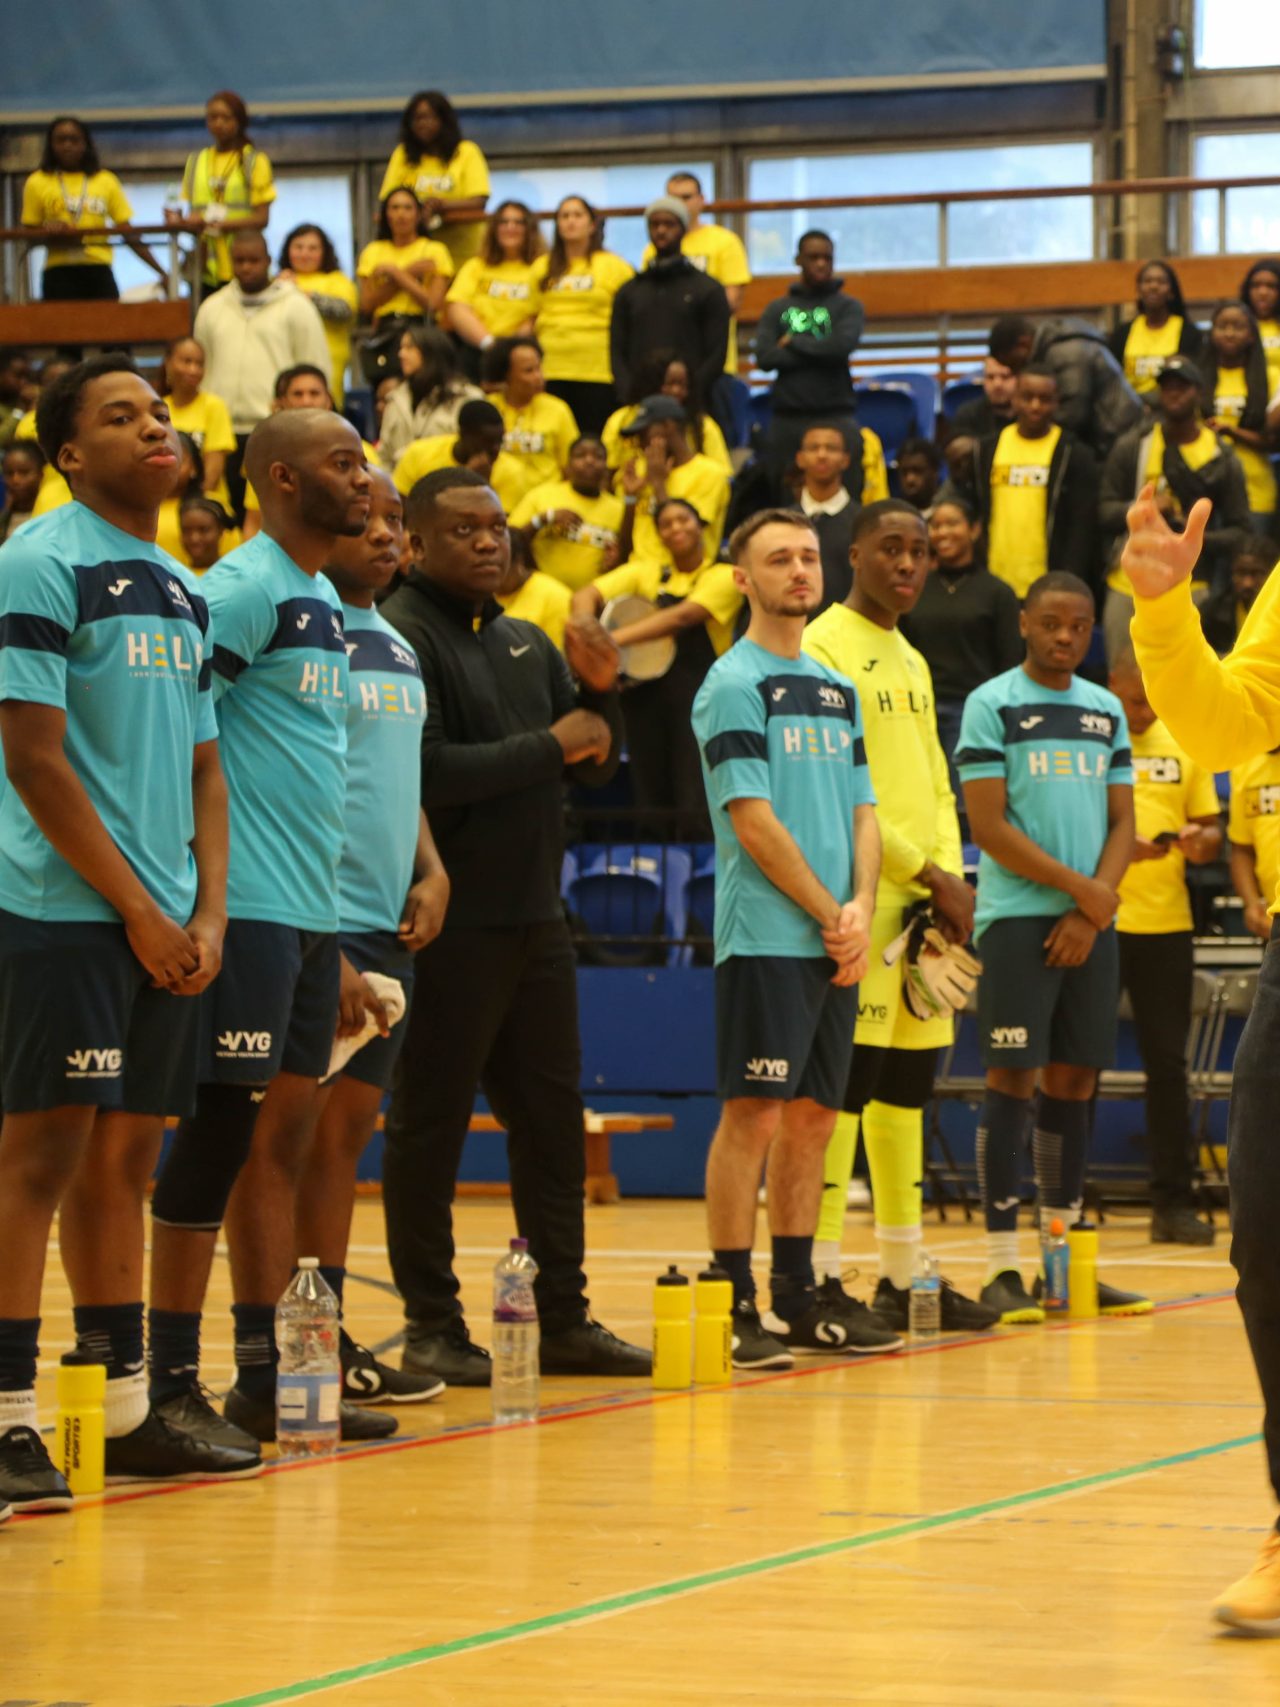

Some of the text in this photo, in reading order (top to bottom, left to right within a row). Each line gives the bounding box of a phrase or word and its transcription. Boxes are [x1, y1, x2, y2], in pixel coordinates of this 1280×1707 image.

[299, 661, 344, 698] HEL
[783, 727, 850, 754] HELP
[218, 1031, 271, 1051] VYG
[990, 1027, 1028, 1044] VYG
[66, 1049, 122, 1071] VYG
[746, 1058, 789, 1077] VYG
